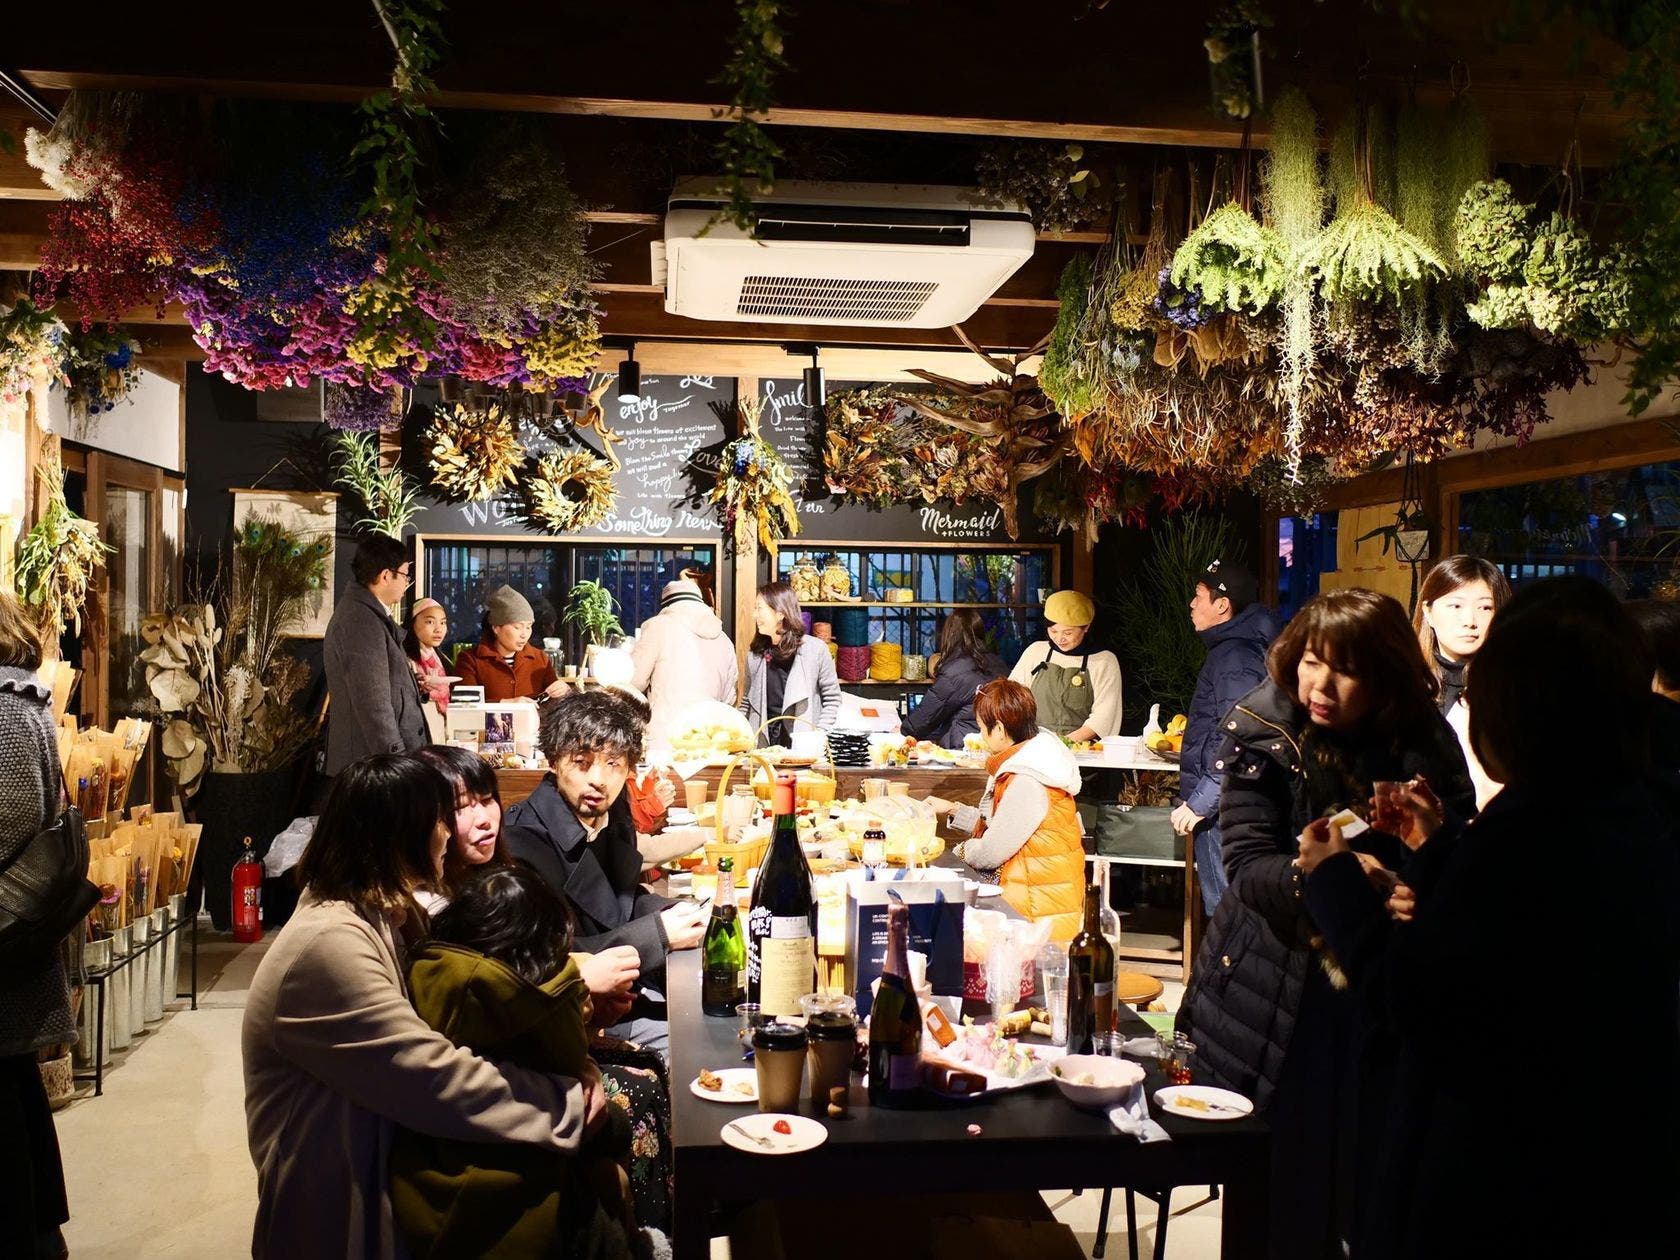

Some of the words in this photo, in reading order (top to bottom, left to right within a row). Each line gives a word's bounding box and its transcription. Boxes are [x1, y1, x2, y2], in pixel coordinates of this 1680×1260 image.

[619, 395, 676, 423] enjoy
[598, 506, 675, 537] Something
[920, 507, 1001, 535] Mermaid
